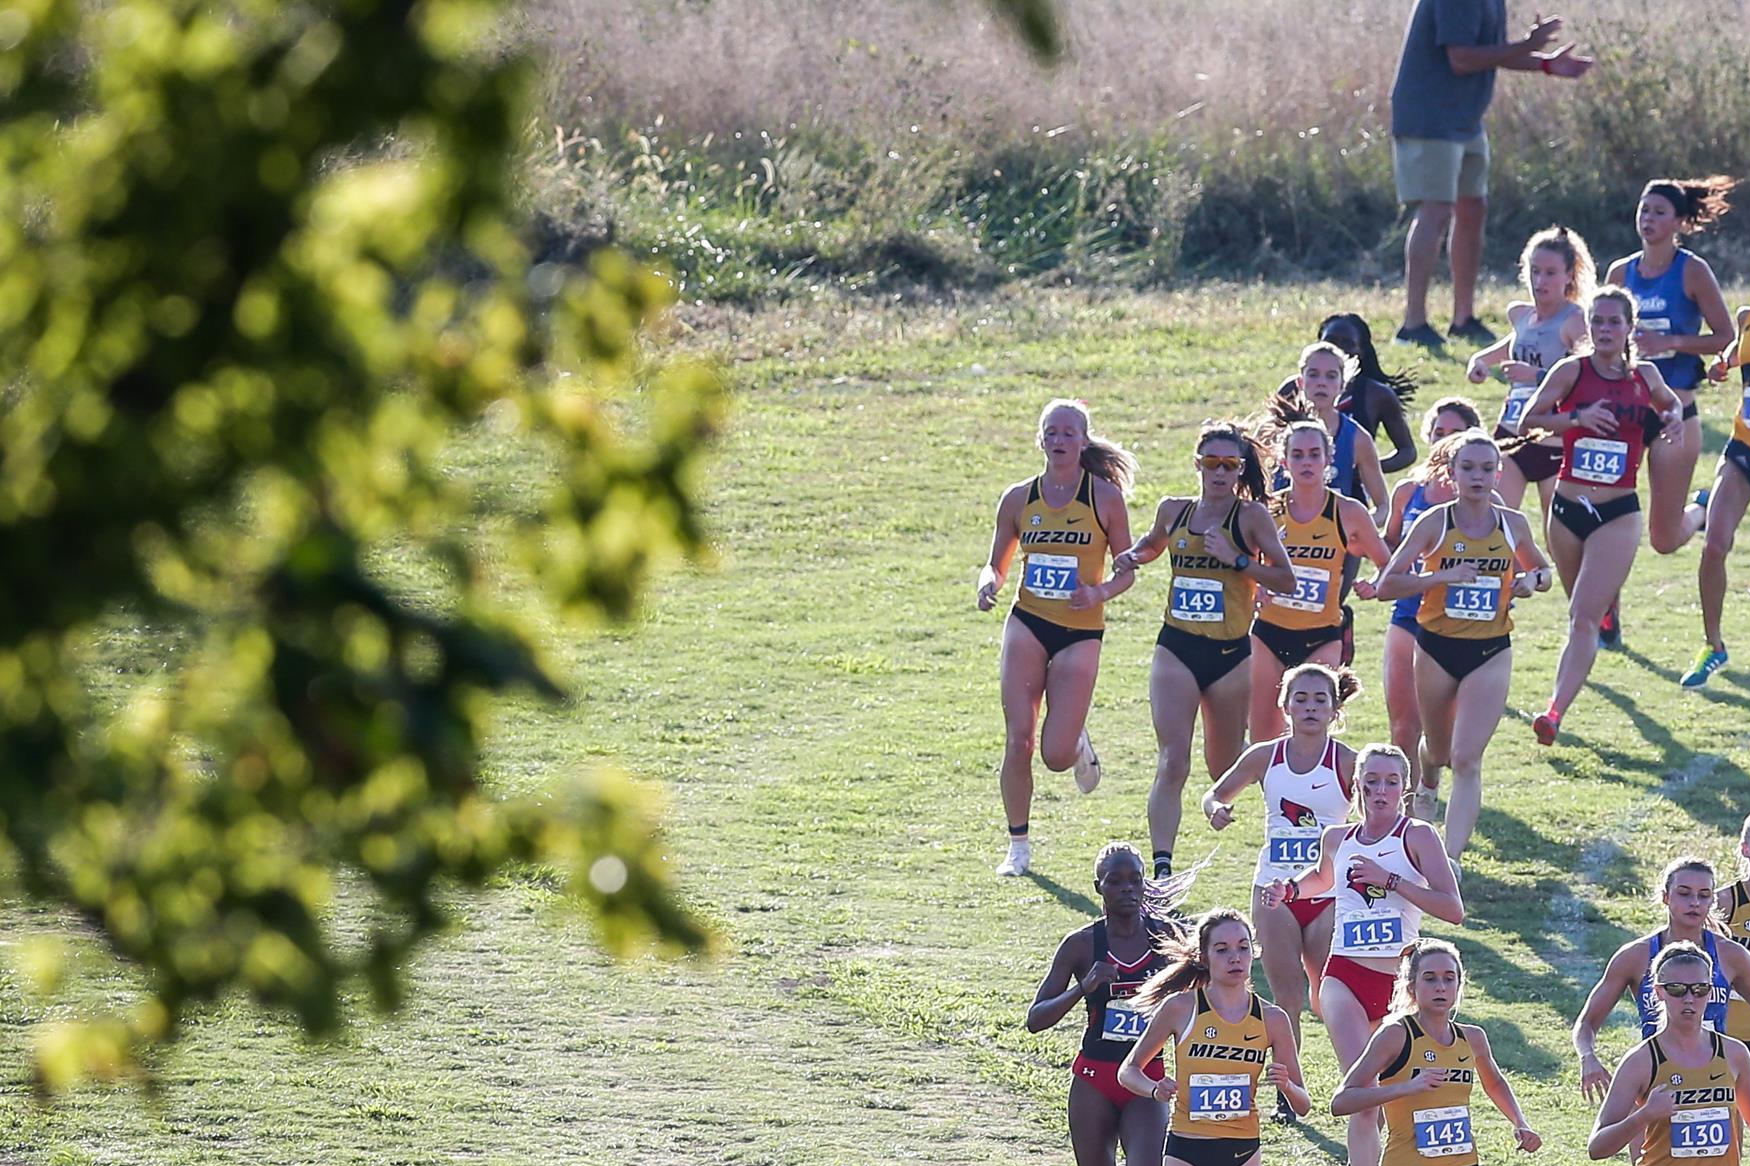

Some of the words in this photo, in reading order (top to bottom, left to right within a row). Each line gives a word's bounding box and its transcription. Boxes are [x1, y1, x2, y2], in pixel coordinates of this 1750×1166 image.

[1581, 451, 1620, 474] 184
[1020, 530, 1092, 546] MIZZOU
[1285, 545, 1337, 561] ZZOU
[1033, 567, 1071, 589] 157
[1179, 591, 1216, 611] 149
[1454, 589, 1493, 610] 131
[1278, 841, 1320, 861] 116
[1352, 921, 1394, 945] 115
[1112, 1012, 1142, 1035] 21
[1187, 1043, 1267, 1065] MIZZOU
[1199, 1088, 1242, 1111] 148
[1671, 1087, 1736, 1106] IZZOU
[1425, 1121, 1466, 1146] 143
[1681, 1122, 1724, 1146] 130
